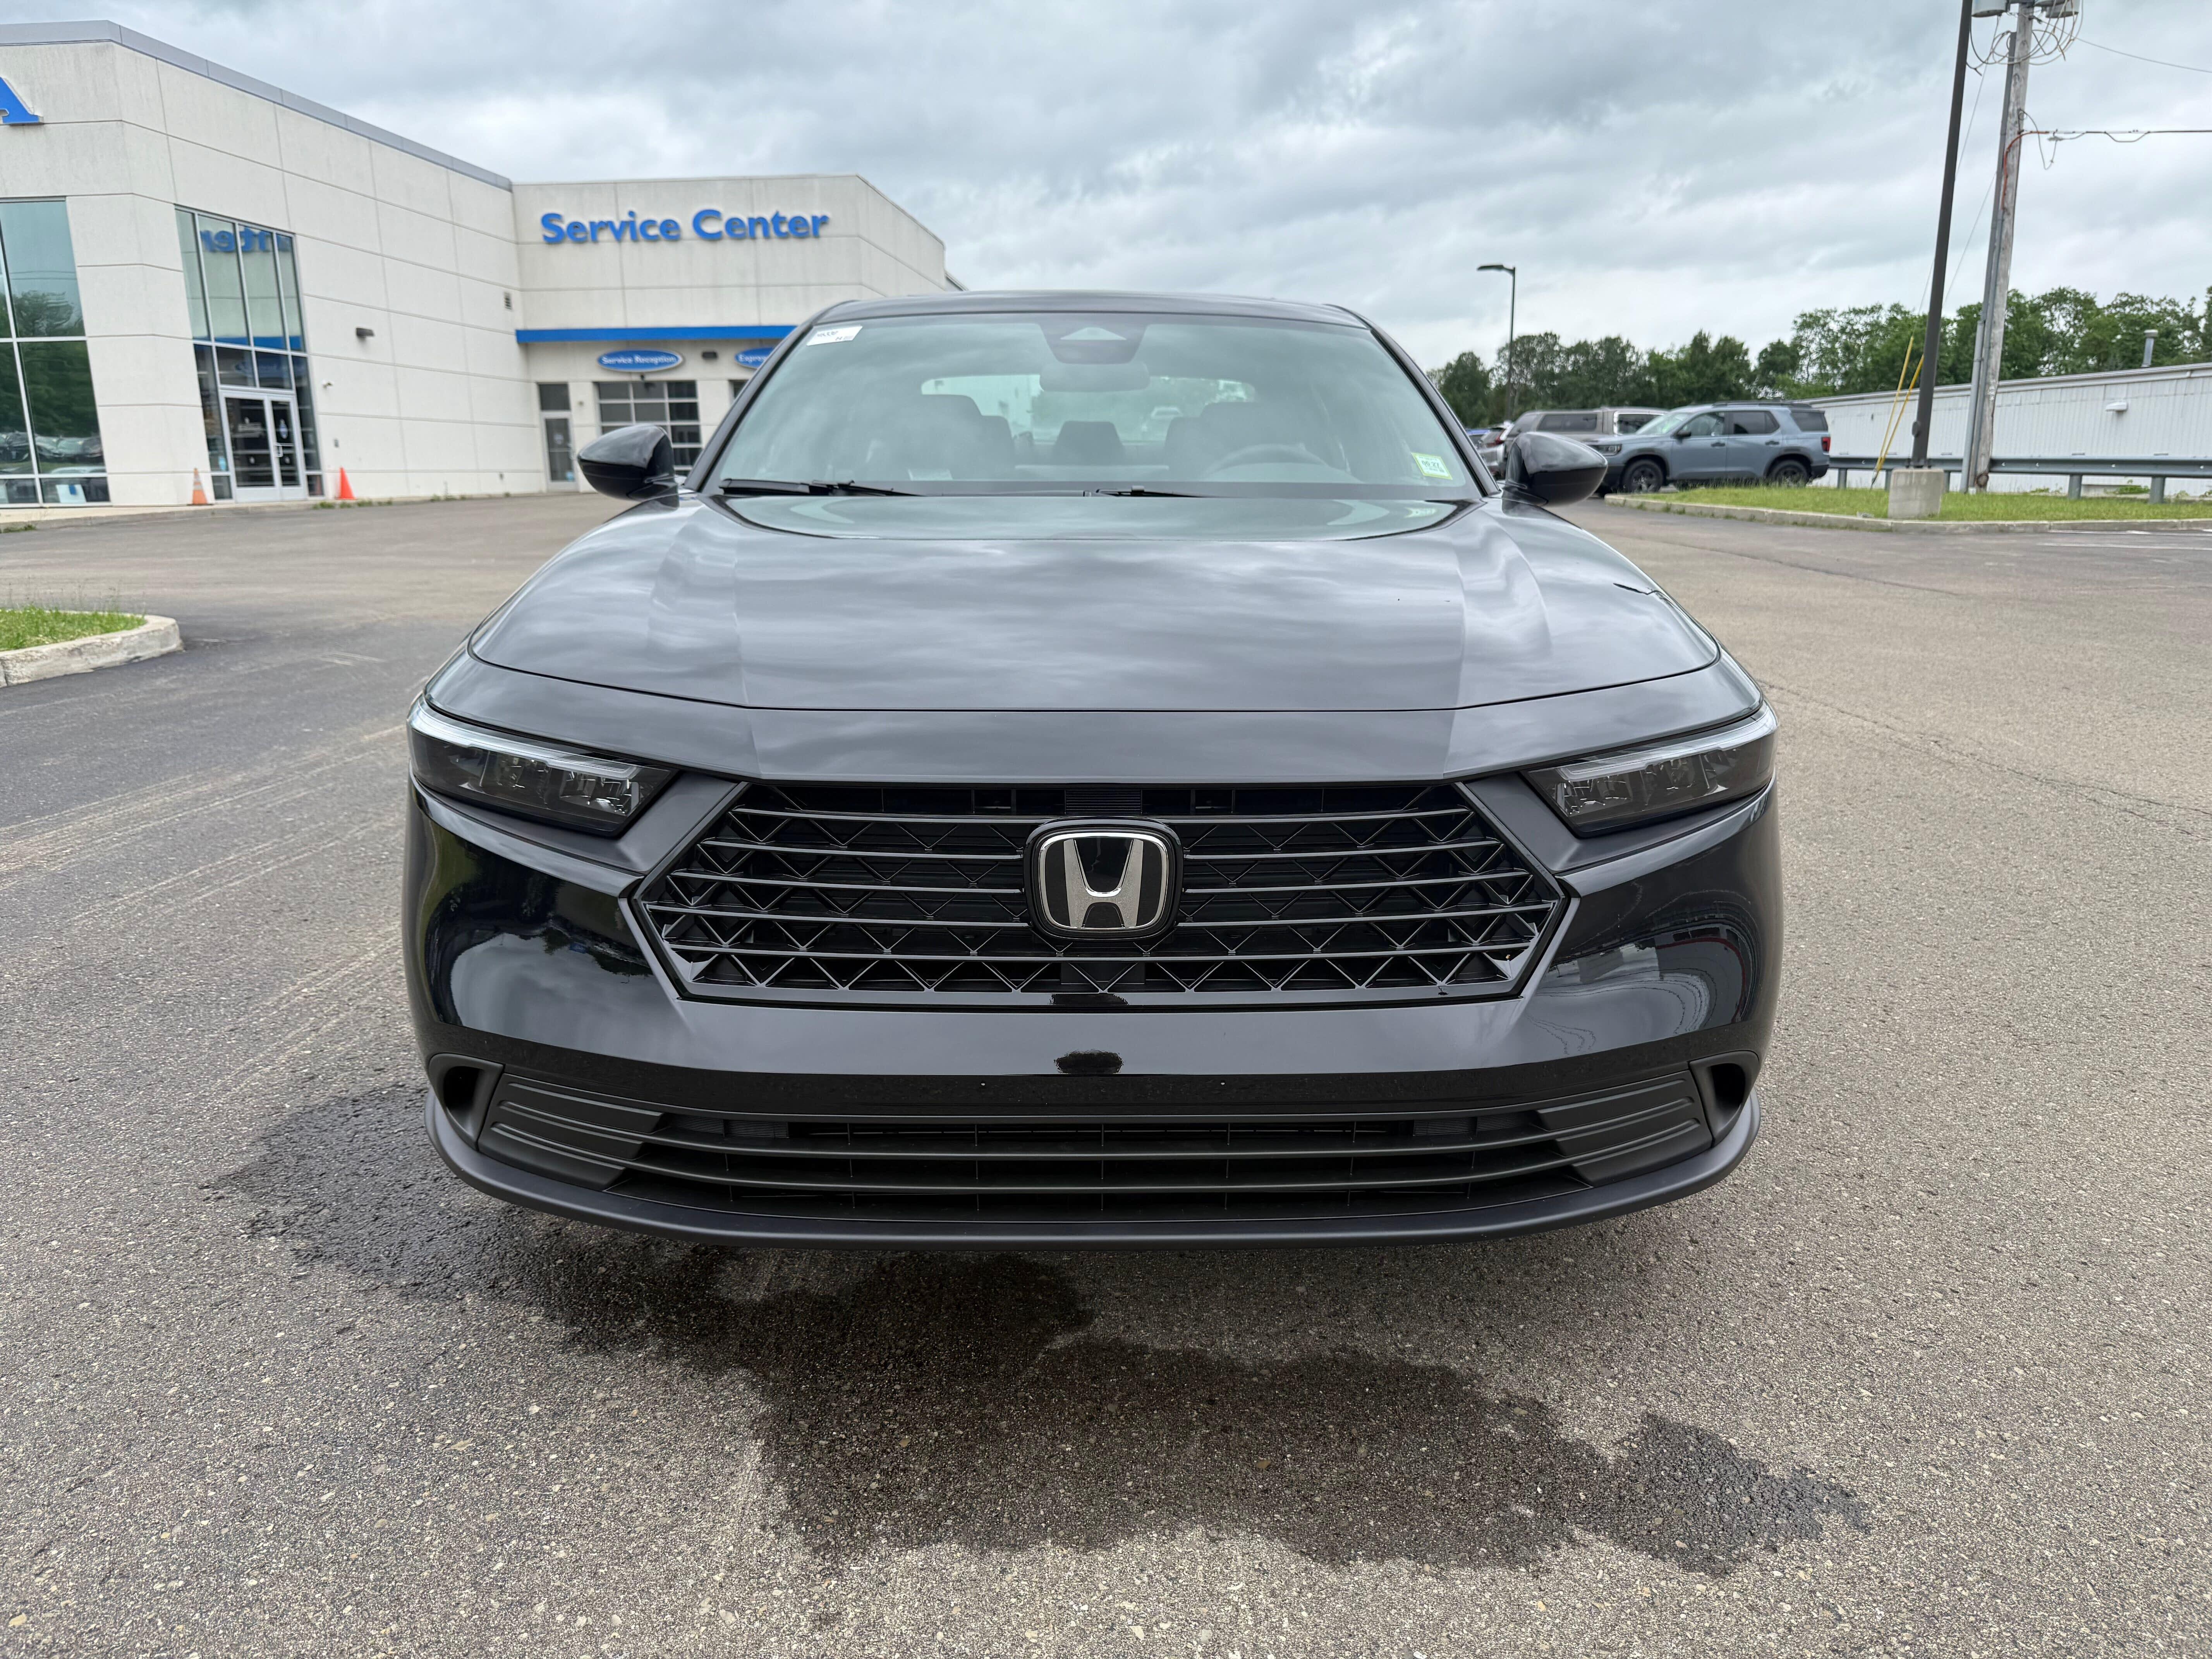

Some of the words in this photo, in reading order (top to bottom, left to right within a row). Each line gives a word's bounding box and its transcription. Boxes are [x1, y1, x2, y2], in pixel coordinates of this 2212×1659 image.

[542, 211, 682, 244] Service
[692, 209, 830, 240] Center
[601, 356, 633, 364] Service
